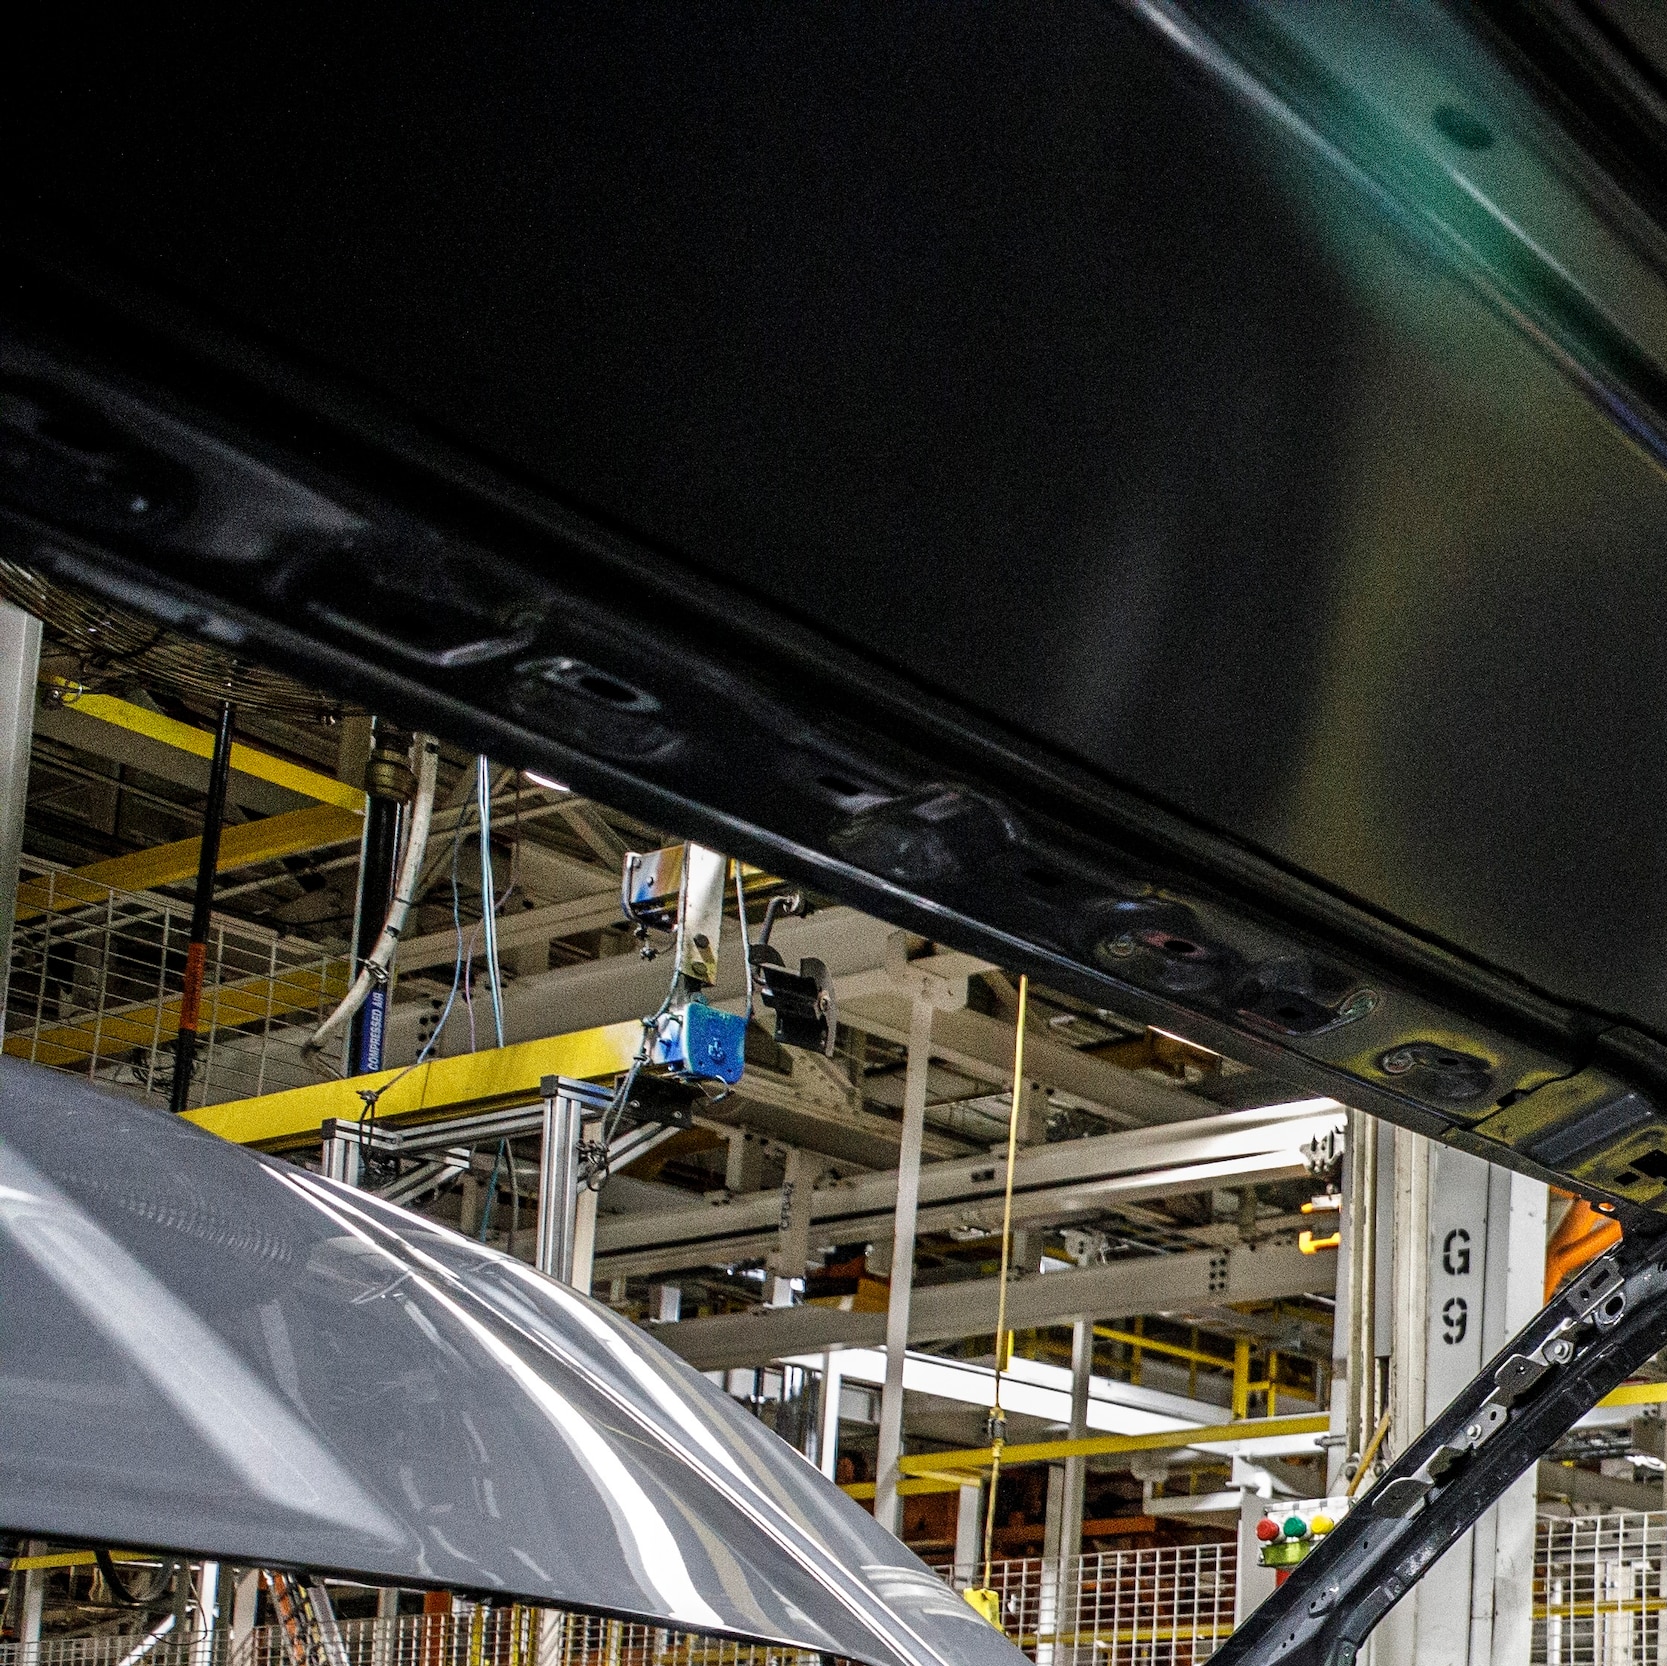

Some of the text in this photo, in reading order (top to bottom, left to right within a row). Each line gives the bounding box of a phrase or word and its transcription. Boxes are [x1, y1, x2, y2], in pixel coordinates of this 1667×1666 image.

[367, 991, 384, 1071] COMPRESSED AIR
[1442, 1227, 1471, 1277] G
[1442, 1295, 1468, 1345] 9
